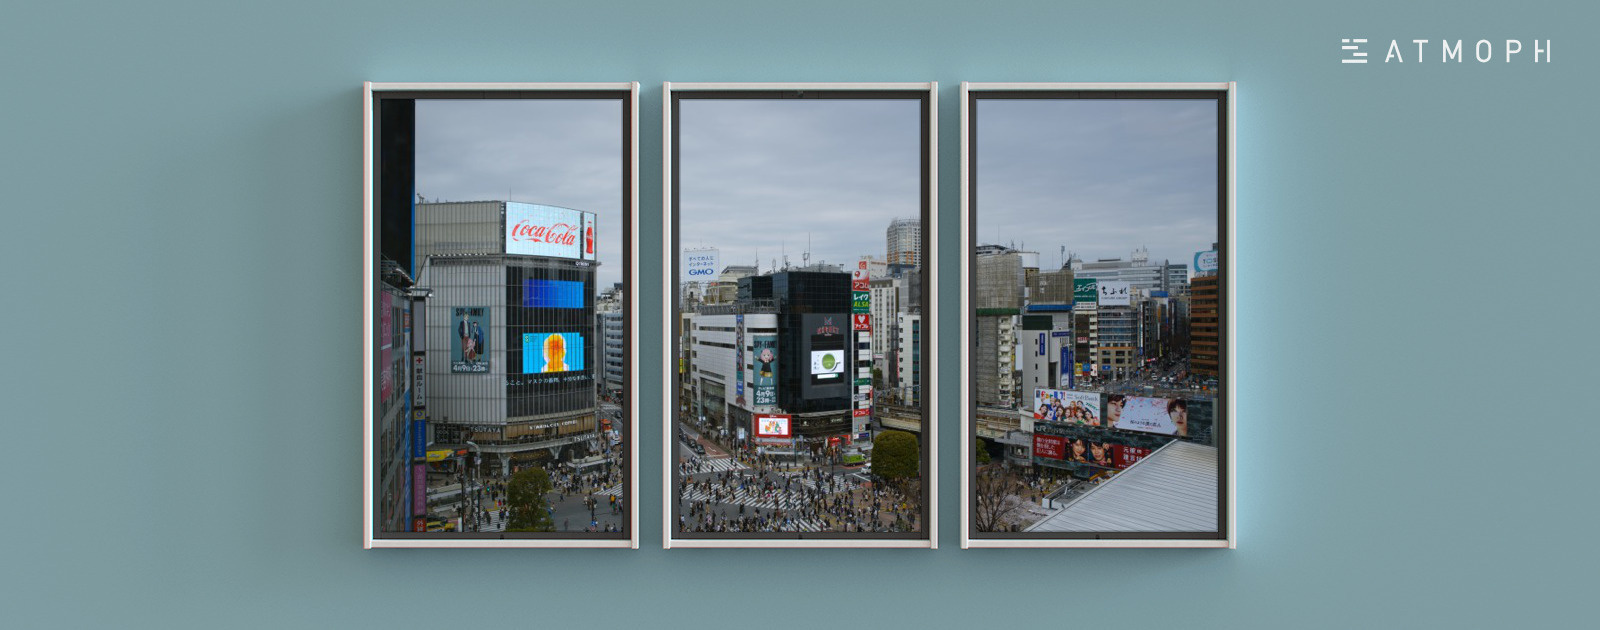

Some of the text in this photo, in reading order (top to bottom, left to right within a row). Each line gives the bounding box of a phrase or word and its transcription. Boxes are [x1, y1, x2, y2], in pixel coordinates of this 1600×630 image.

[512, 219, 579, 246] Coca-Cola
[1101, 286, 1128, 295] ちふれ
